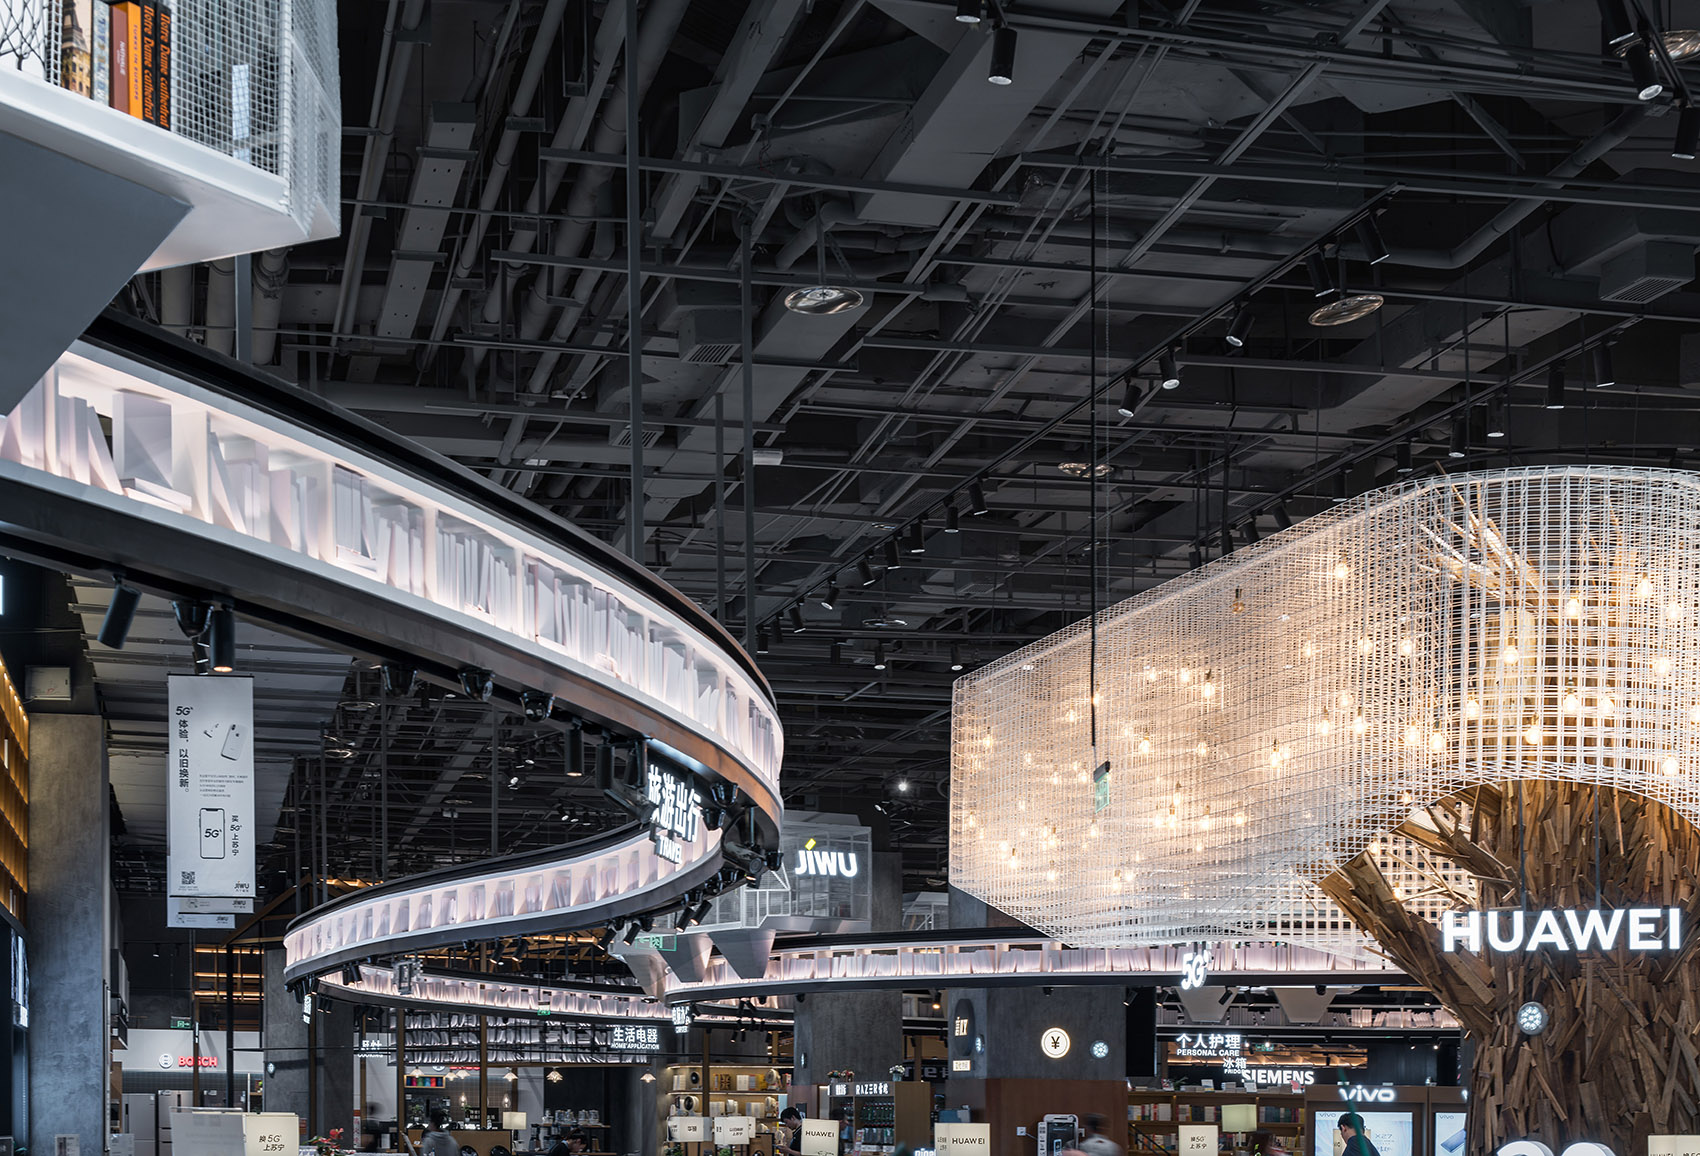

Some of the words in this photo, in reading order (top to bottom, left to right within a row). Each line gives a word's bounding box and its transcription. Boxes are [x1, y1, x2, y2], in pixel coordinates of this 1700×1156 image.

[144, 37, 155, 67] Dame
[160, 44, 171, 75] Dame
[144, 69, 154, 120] cathedral
[160, 77, 170, 128] cathedral
[176, 706, 192, 716] 5G
[204, 828, 221, 838] 5G
[1443, 908, 1681, 952] HUAWEI
[1181, 951, 1207, 990] 5G
[613, 1027, 658, 1043] 生活电器
[1176, 1033, 1241, 1049] 个人护理
[1223, 1057, 1247, 1069] 冰箱
[1241, 1069, 1315, 1085] SIEMENS
[1338, 1085, 1396, 1102] vivo
[263, 1144, 285, 1152] 上苏宁
